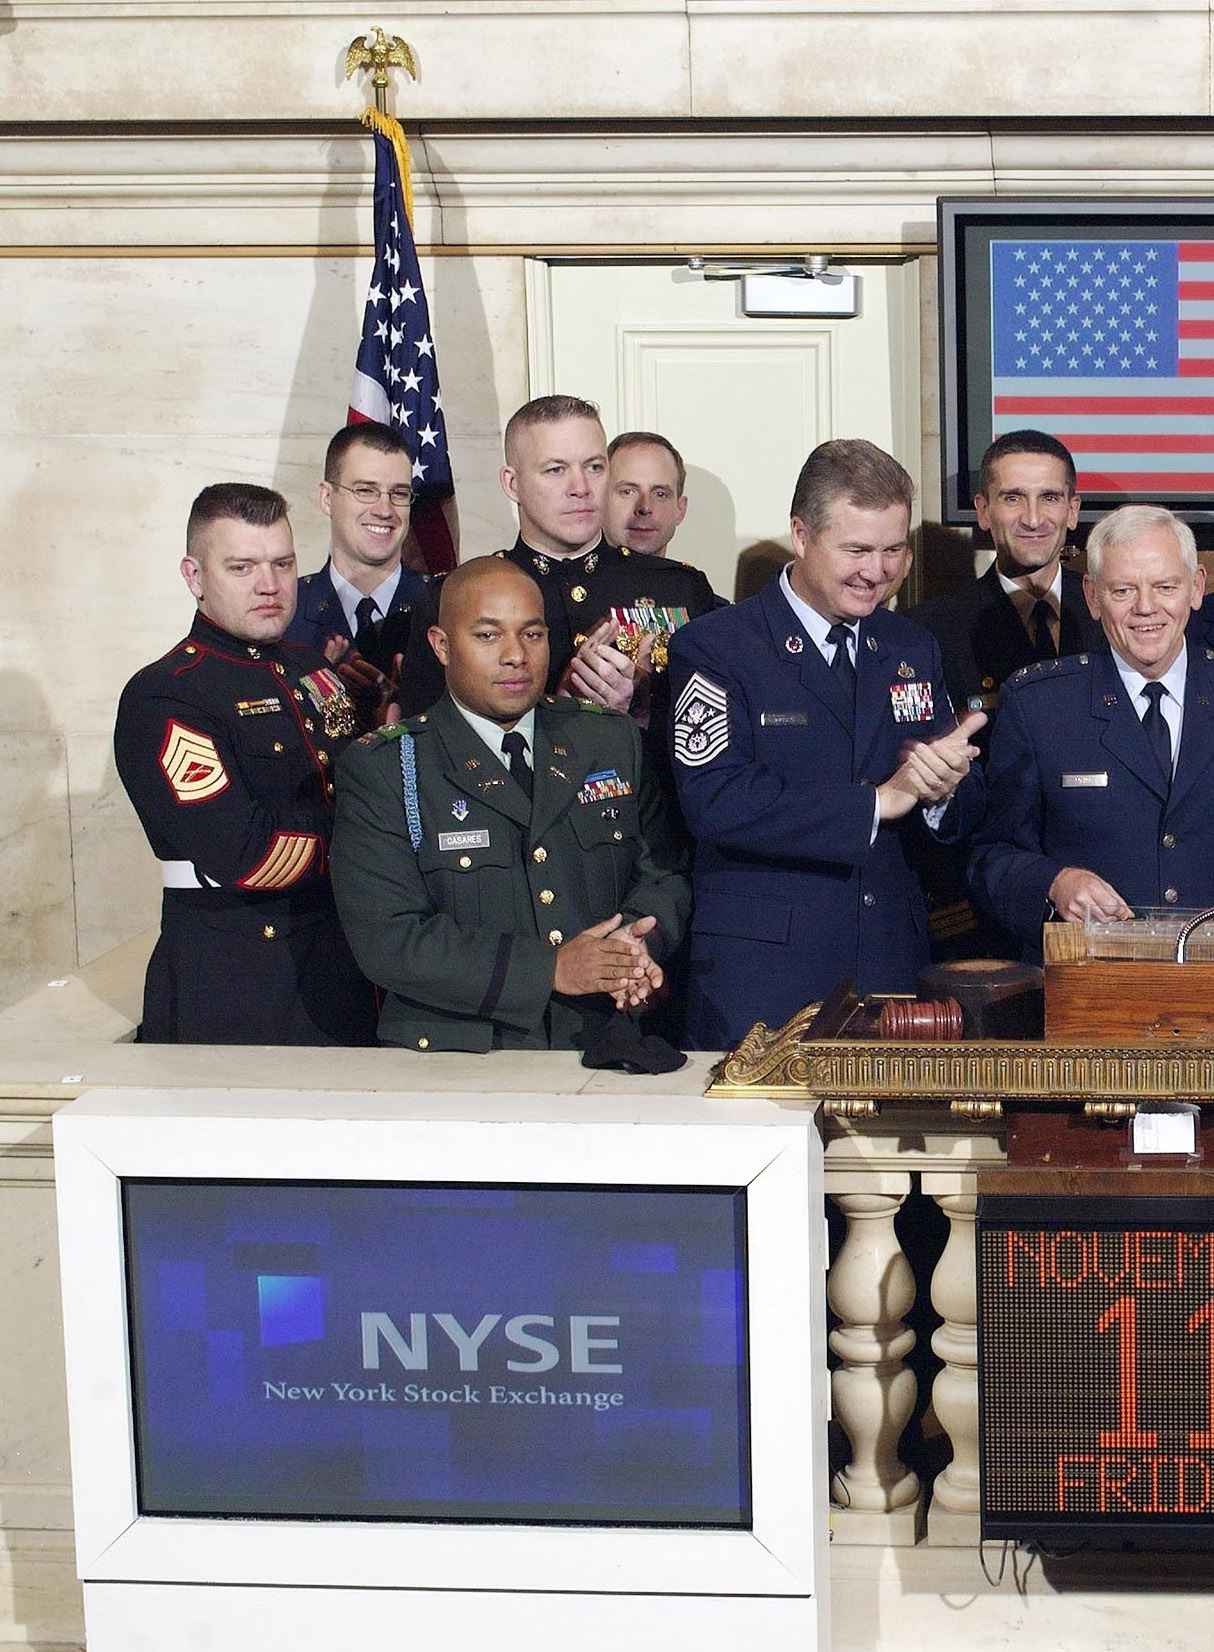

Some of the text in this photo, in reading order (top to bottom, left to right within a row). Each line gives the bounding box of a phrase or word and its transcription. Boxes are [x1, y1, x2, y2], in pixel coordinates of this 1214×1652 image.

[446, 834, 482, 845] CASARES
[361, 1312, 623, 1374] NYSE
[263, 1381, 624, 1411] New York Stock Exchange
